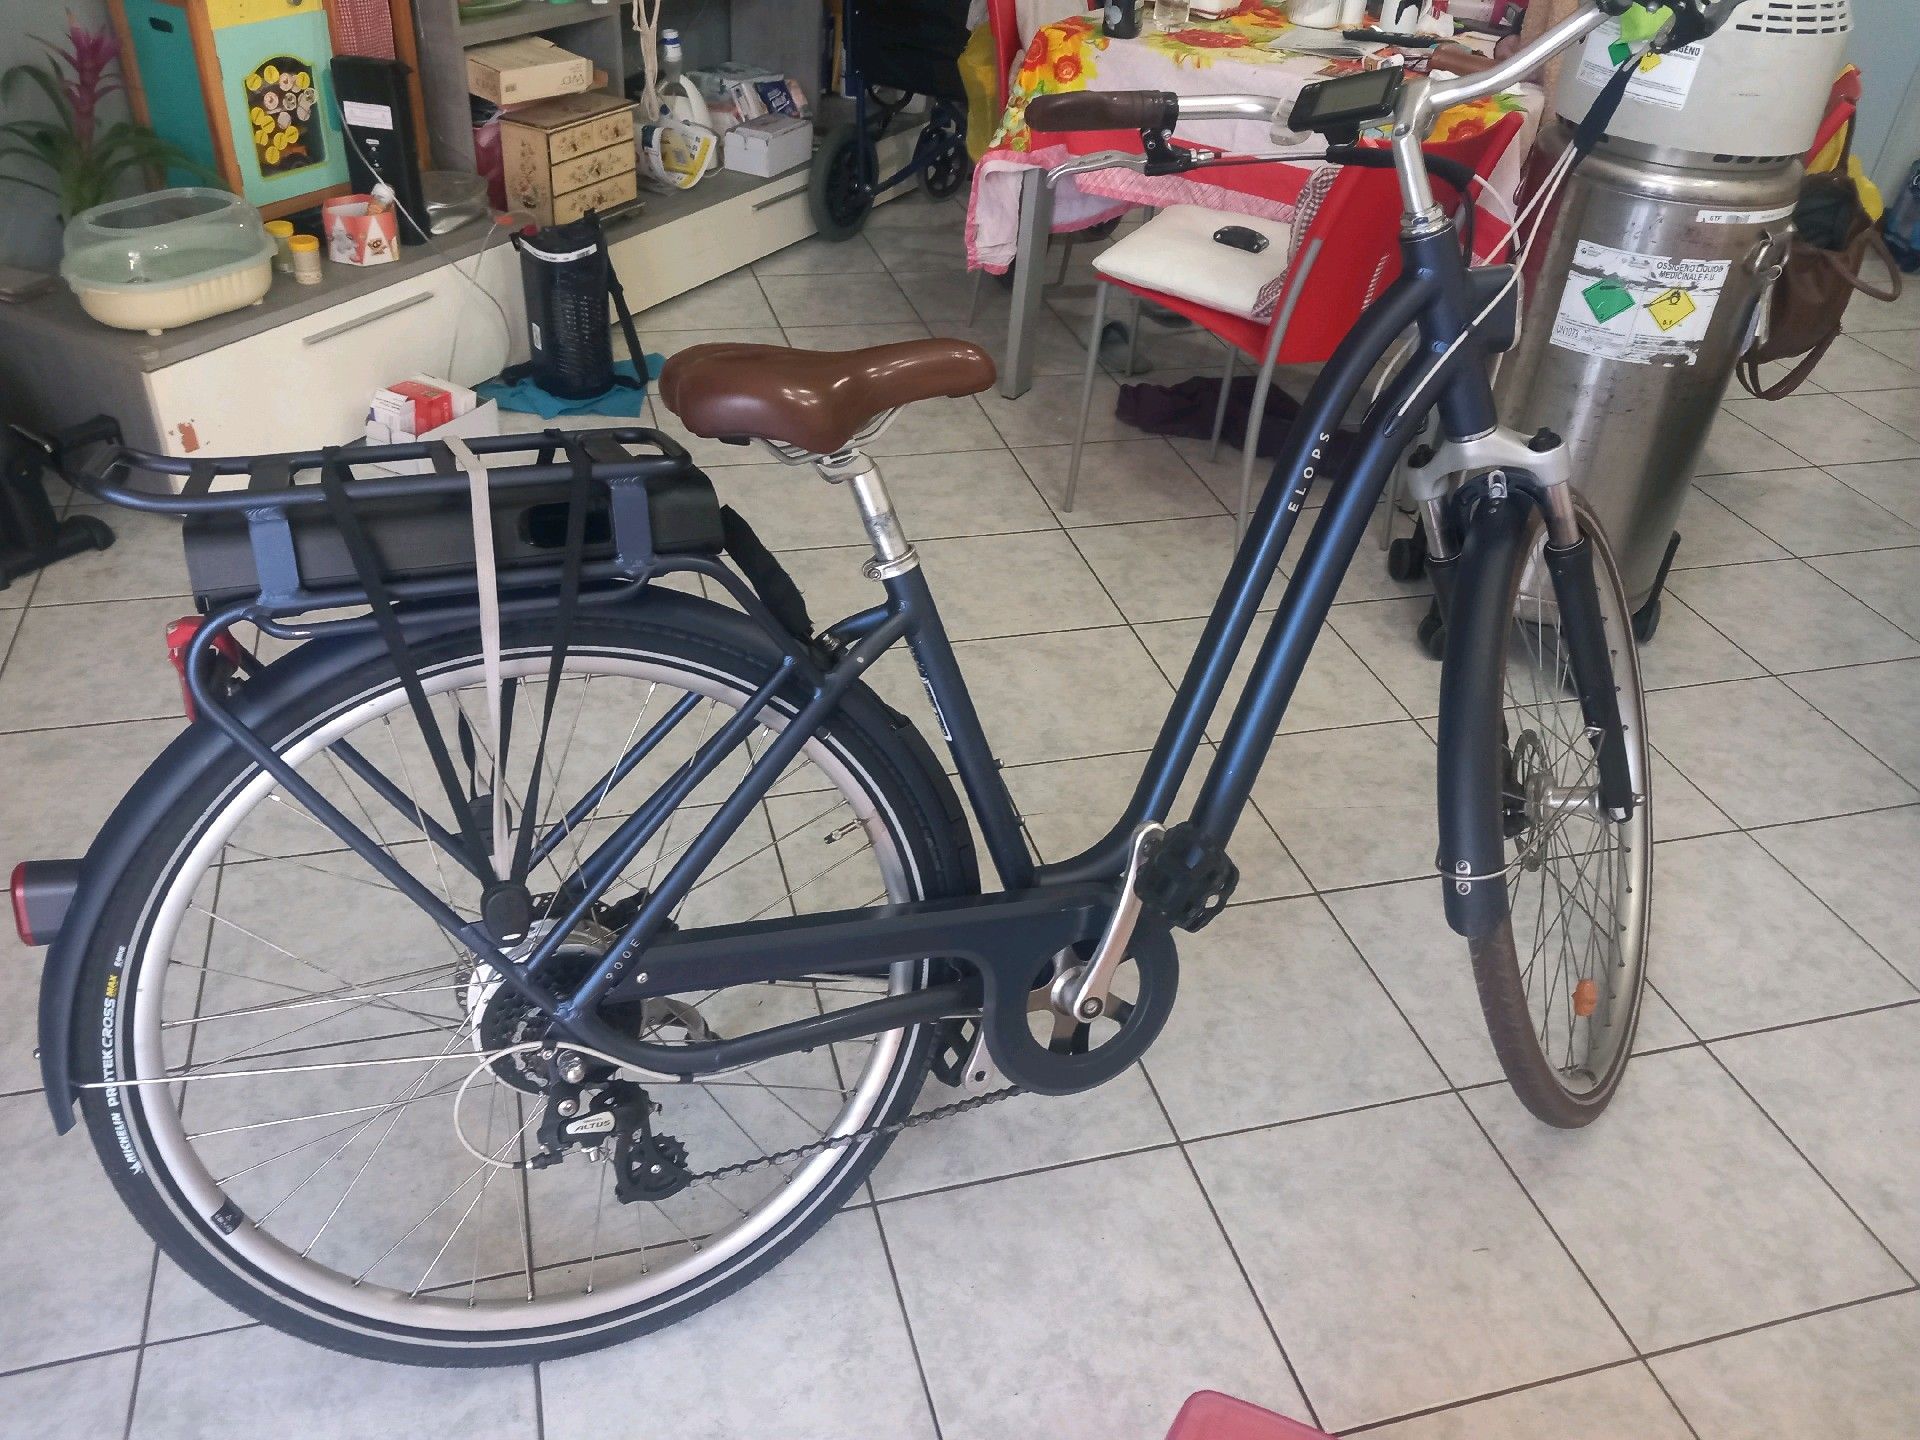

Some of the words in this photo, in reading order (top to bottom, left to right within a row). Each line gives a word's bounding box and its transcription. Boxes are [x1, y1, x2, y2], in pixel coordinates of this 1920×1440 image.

[1659, 270, 1703, 281] MEDICINALE
[1287, 432, 1330, 513] ELOPS
[605, 938, 641, 980] 900E
[105, 974, 119, 998] MAX
[101, 997, 116, 1048] CROSS
[111, 1112, 137, 1163] MICHELIN
[574, 1119, 612, 1132] ALTUS
